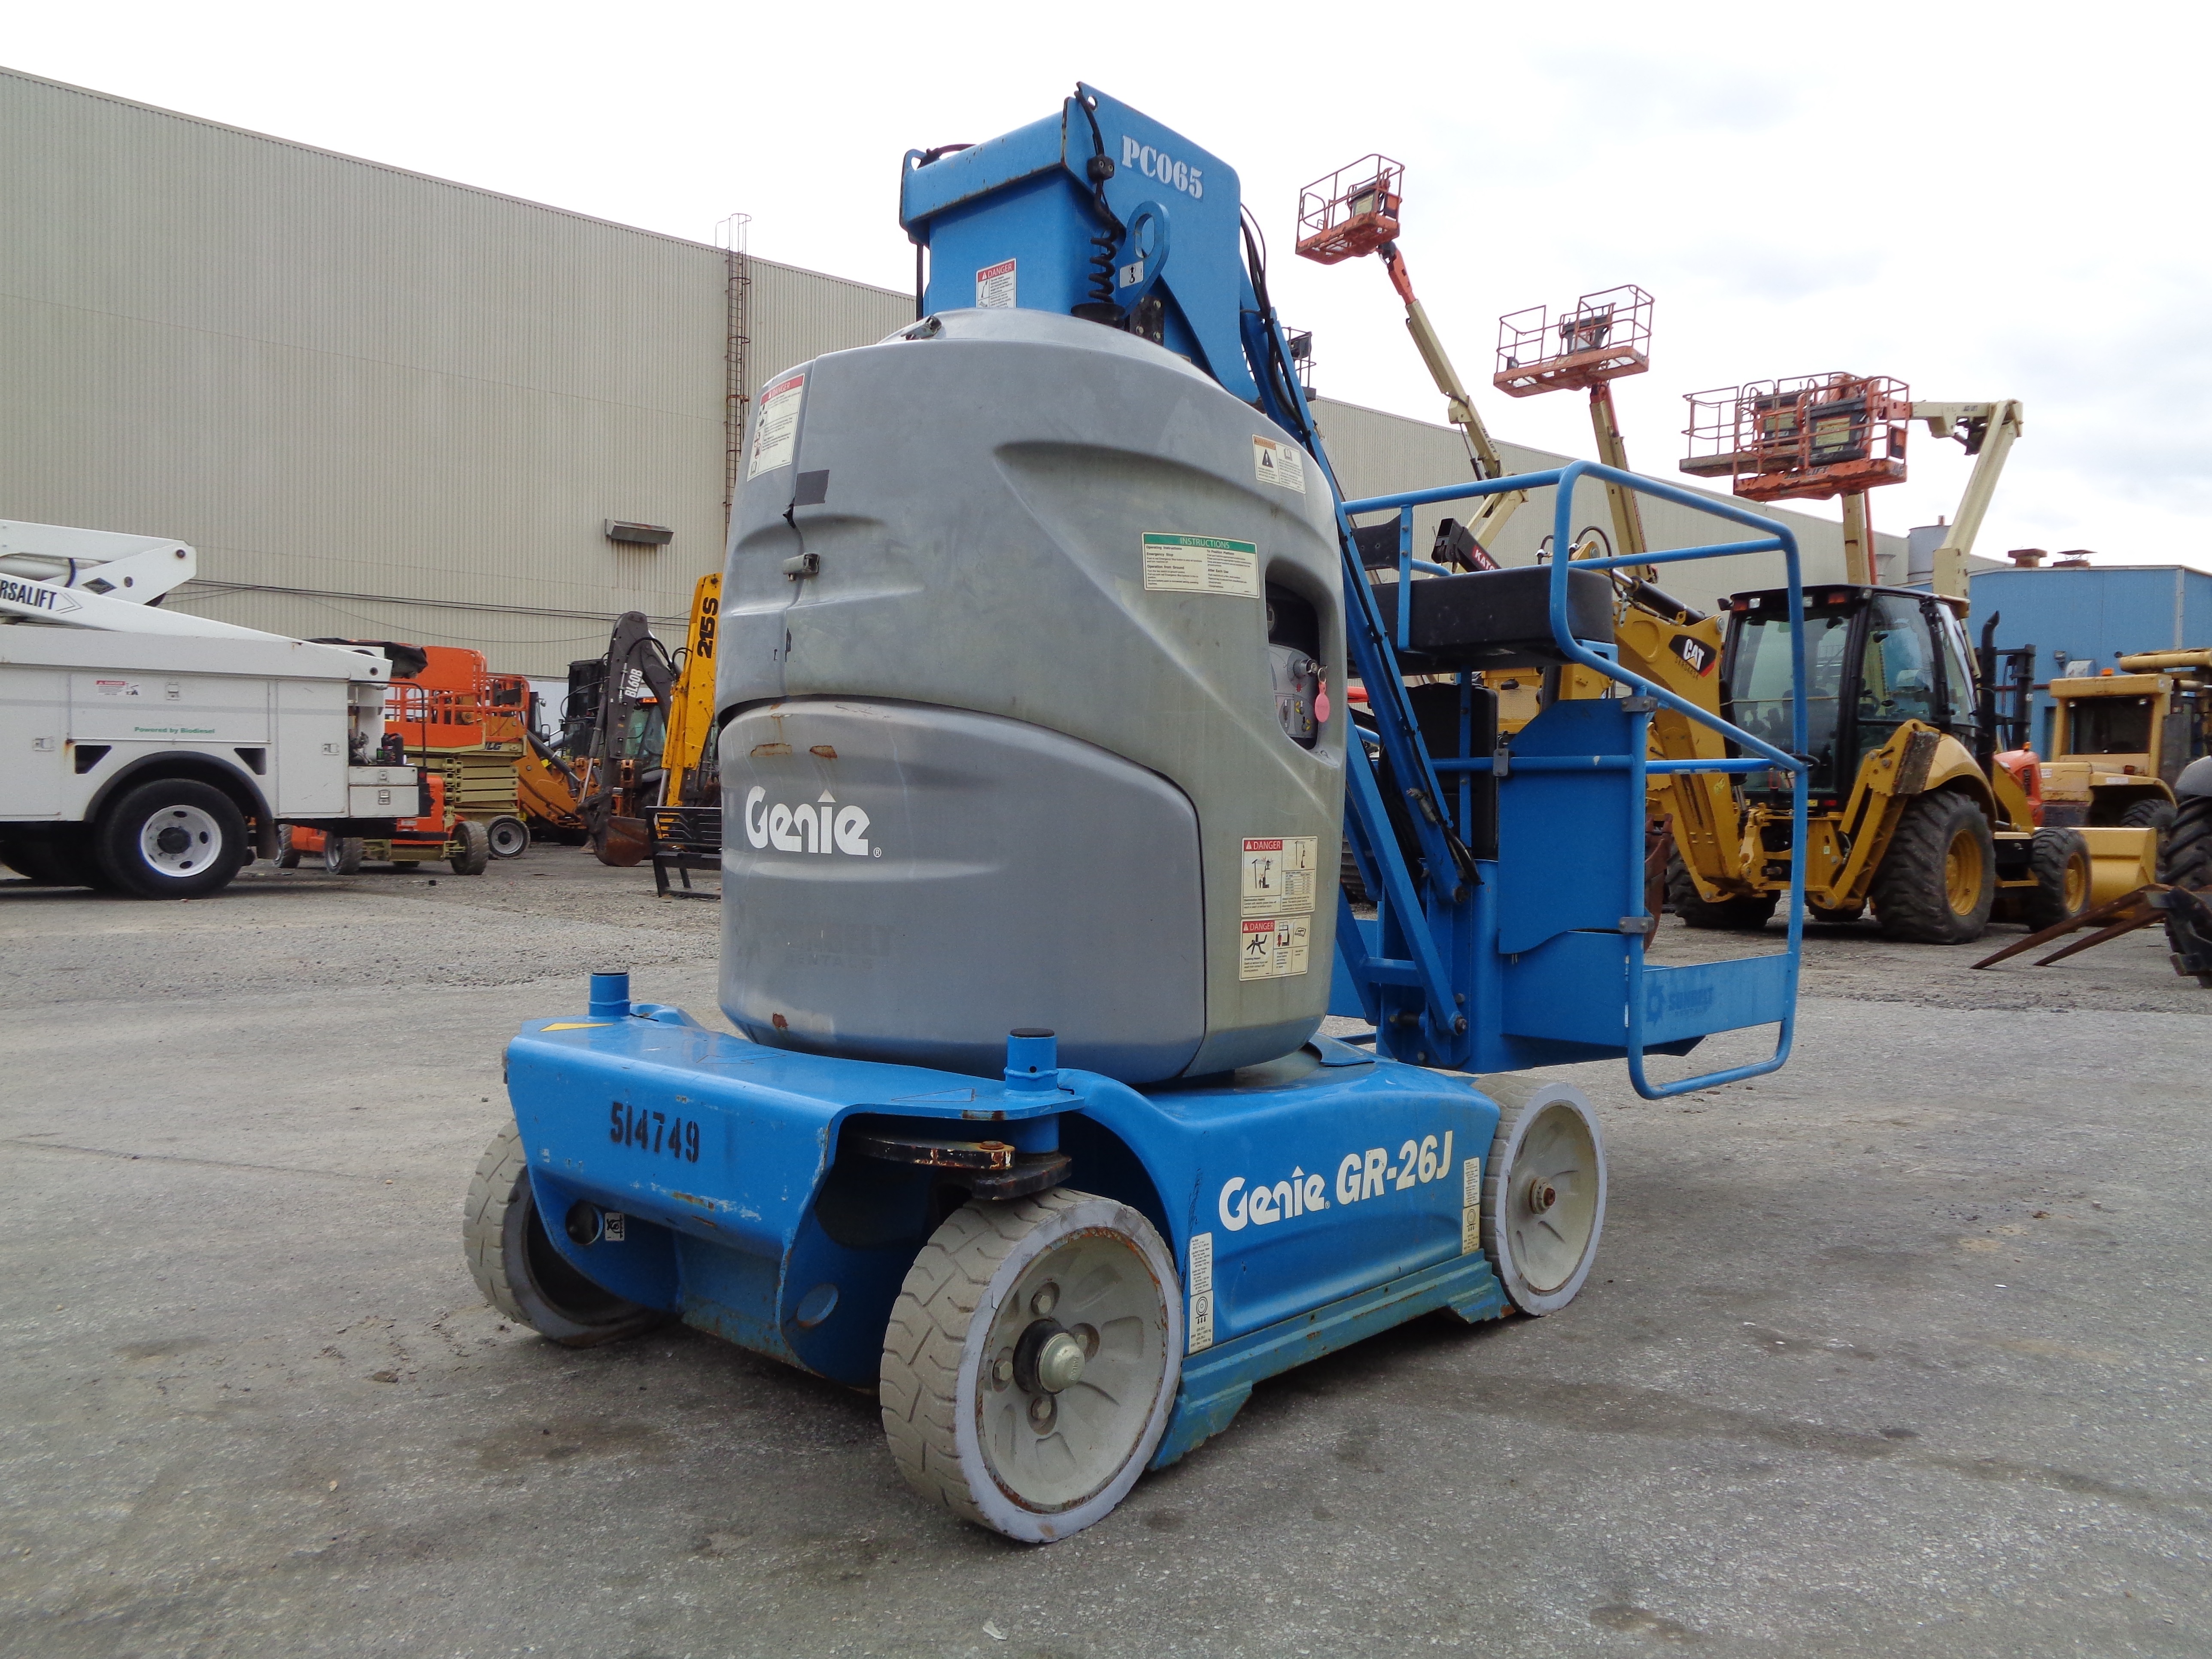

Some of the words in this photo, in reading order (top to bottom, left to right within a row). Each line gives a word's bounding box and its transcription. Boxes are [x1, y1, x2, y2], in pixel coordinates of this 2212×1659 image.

[988, 263, 1012, 278] DANGER
[1180, 537, 1230, 549] INSTRUCTIONS
[1683, 638, 1705, 671] CAT
[625, 668, 643, 699] BL60B
[485, 742, 502, 750] LG
[745, 786, 870, 856] Genie
[1254, 841, 1281, 850] DANGER
[1250, 922, 1274, 931] DANGER
[611, 1101, 699, 1163] 514749
[1219, 1165, 1325, 1231] Genie
[1336, 1130, 1453, 1205] GR-26J
